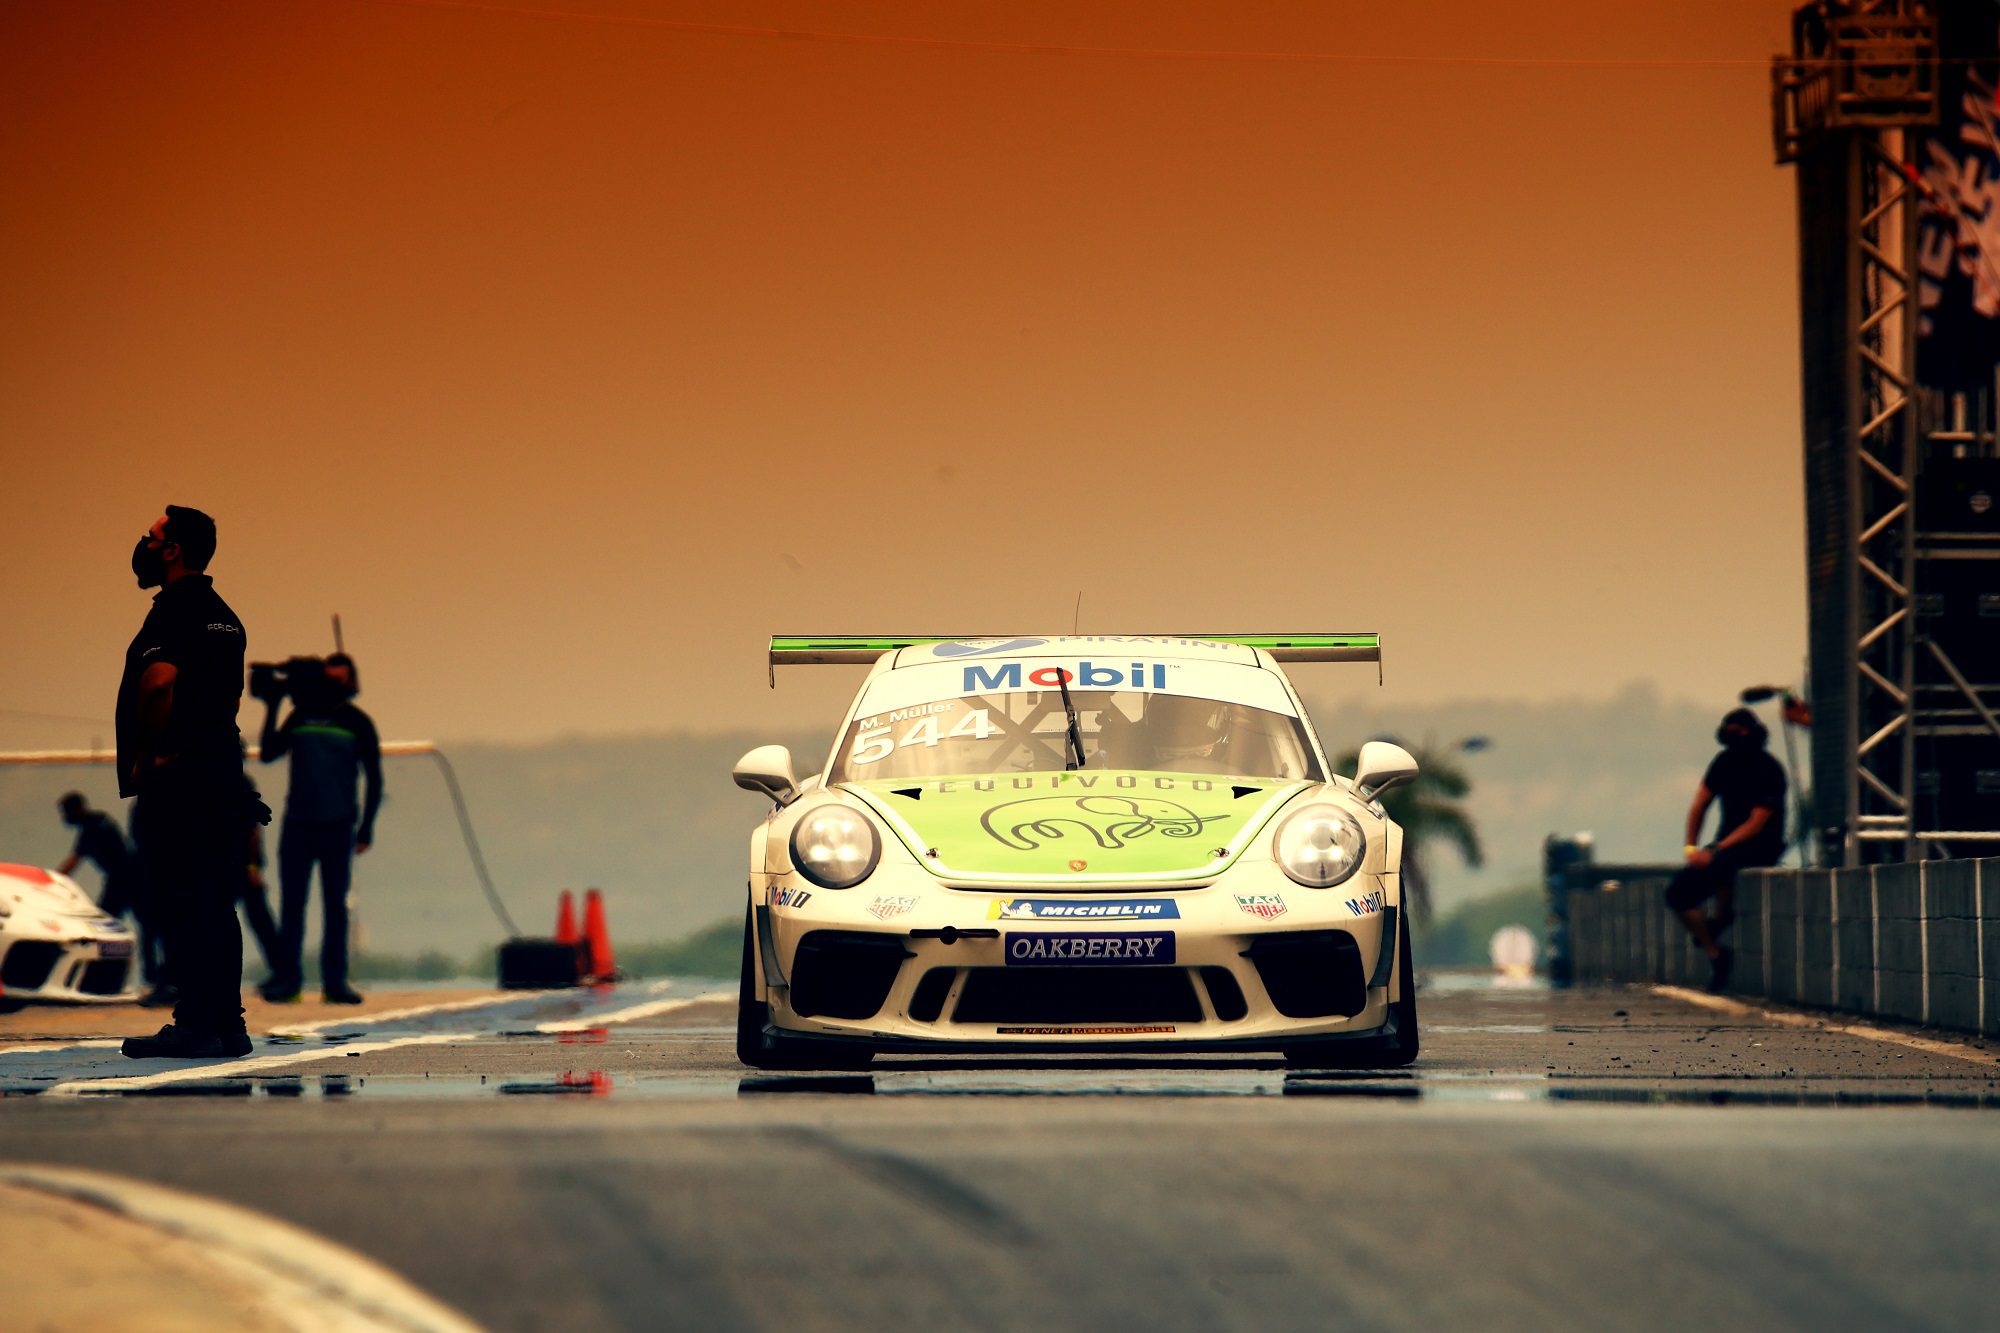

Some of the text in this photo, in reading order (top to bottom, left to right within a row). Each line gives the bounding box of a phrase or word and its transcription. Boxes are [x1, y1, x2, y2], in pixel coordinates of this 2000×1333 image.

[963, 661, 1166, 692] Mobil
[859, 702, 955, 732] M. Müller
[851, 708, 996, 766] 544
[939, 775, 1213, 793] EQUIVOCO
[1040, 905, 1162, 916] MICHELIN
[1238, 896, 1280, 904] TAG
[1242, 904, 1285, 917] HEUER
[1345, 892, 1378, 916] Mobil
[1012, 937, 1163, 959] OAKBERRY
